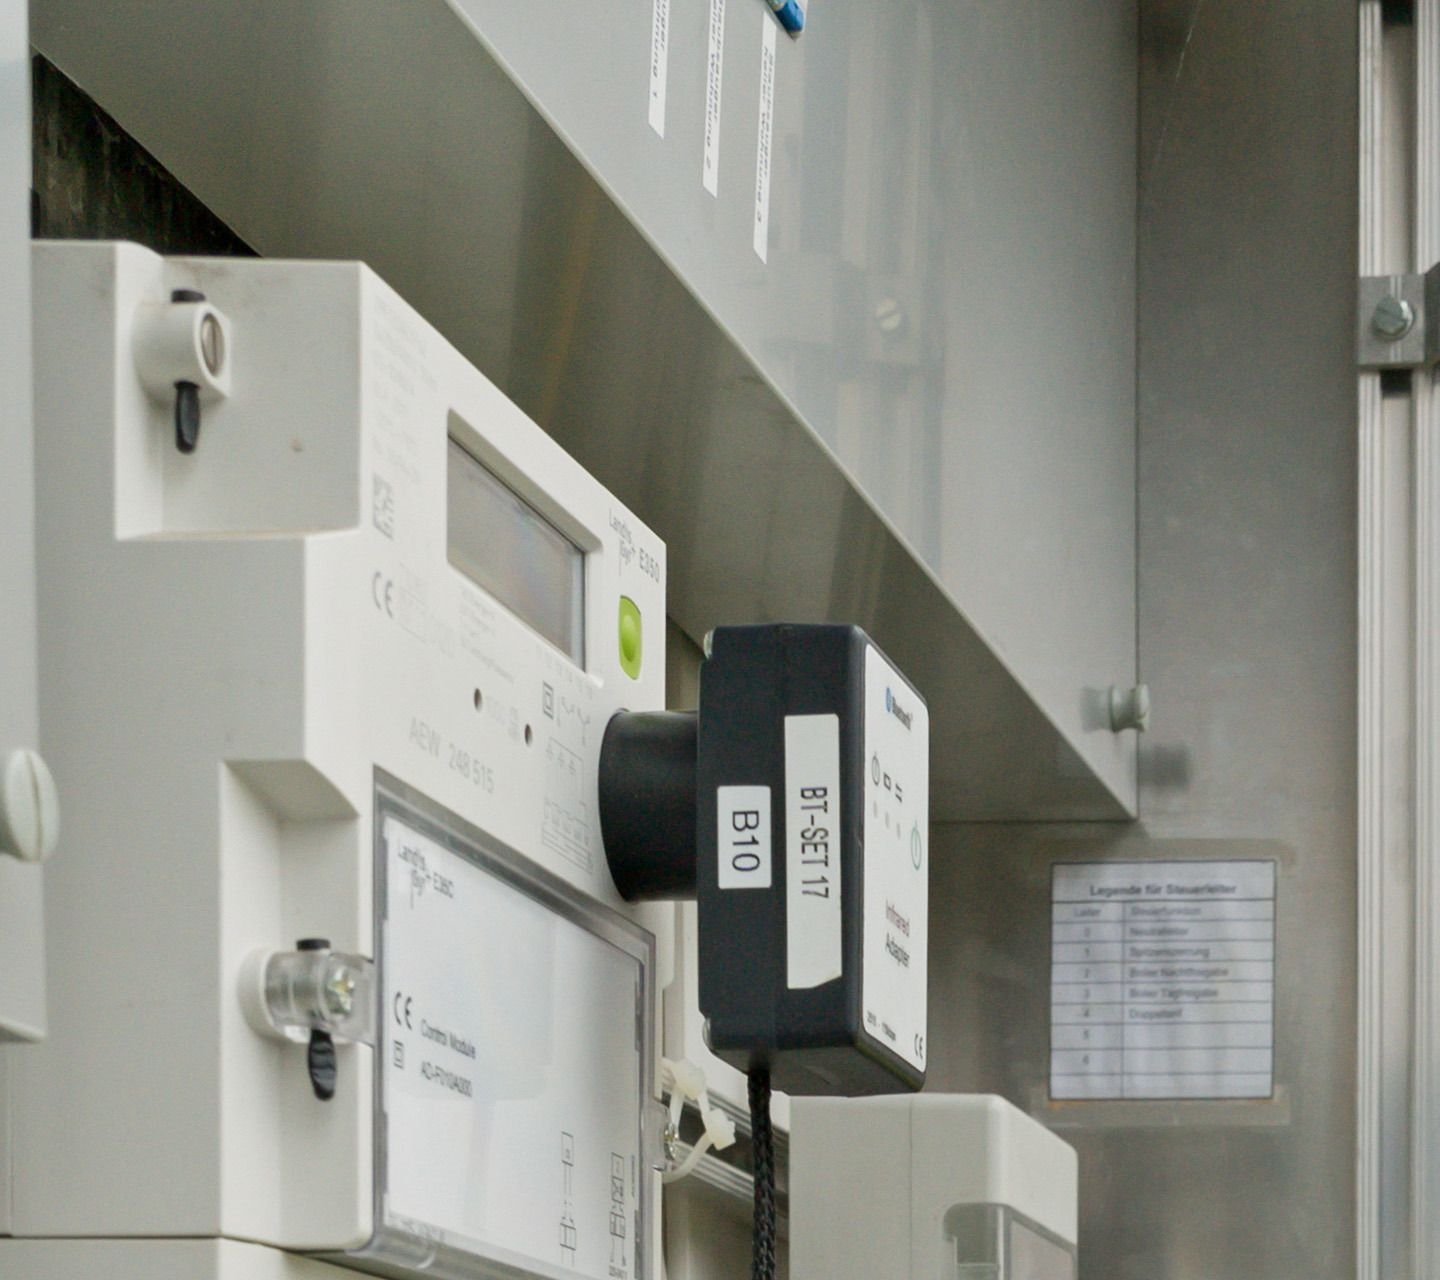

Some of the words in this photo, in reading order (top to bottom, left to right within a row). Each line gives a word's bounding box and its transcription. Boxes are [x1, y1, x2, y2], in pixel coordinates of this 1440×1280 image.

[410, 716, 441, 758] AEW
[472, 759, 496, 795] 515
[732, 810, 761, 872] B10
[800, 787, 829, 867] BT-SET
[801, 876, 829, 899] 17
[1089, 884, 1142, 898] Legende
[1145, 883, 1163, 895] für
